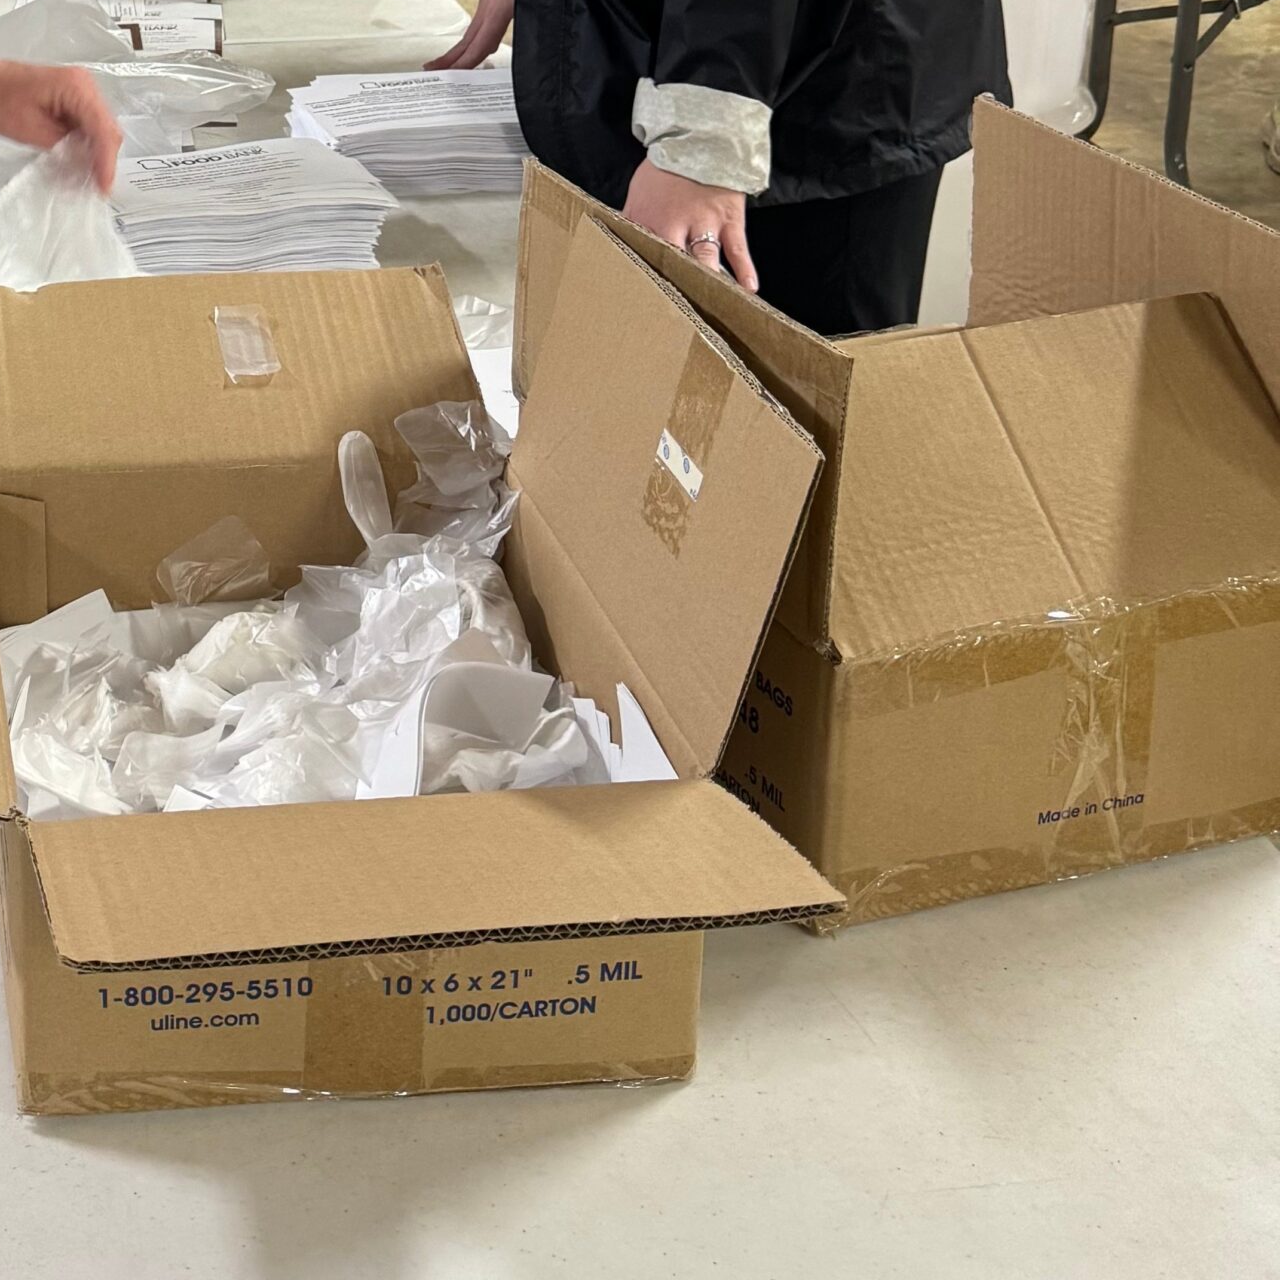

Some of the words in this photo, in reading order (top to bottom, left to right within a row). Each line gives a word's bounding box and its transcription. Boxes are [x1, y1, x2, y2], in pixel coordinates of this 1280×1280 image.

[1037, 806, 1081, 825] Made
[1084, 802, 1098, 817] in
[1102, 793, 1145, 812] China
[98, 976, 314, 1009] 1-800-295-5510
[381, 975, 413, 996] 10
[420, 977, 436, 994] x
[443, 972, 460, 993] 6
[467, 975, 484, 991] x
[490, 968, 534, 990] 21"
[566, 964, 591, 985] .5
[599, 960, 643, 983] MIL
[150, 1013, 261, 1032] uline.com
[425, 996, 598, 1026] 1,000/CARTON
